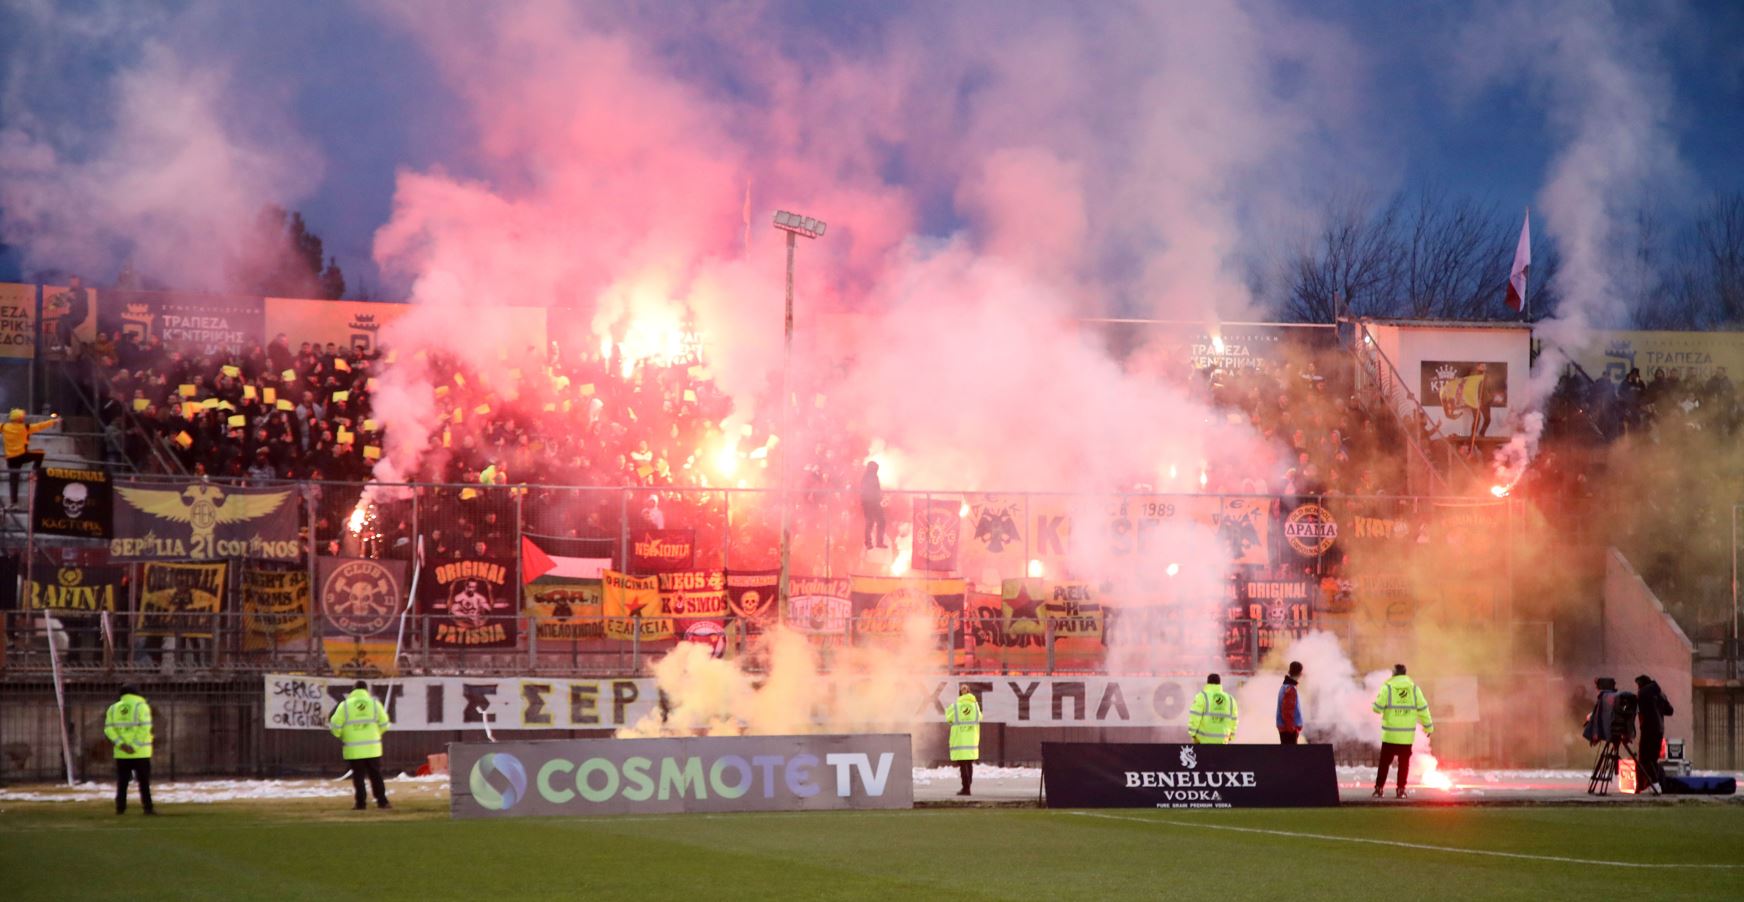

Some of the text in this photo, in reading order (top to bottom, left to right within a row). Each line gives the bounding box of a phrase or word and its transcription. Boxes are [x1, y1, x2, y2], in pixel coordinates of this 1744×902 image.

[161, 314, 229, 329] ΤΡΑΠΕΖΑ
[1646, 351, 1713, 364] ΤΡΑΠΕΖΑ
[46, 467, 106, 482] ORIGINAL
[1142, 503, 1176, 517] 1989
[1286, 523, 1336, 536] ΔΡΑΜΑ
[190, 533, 214, 560] 21
[343, 565, 381, 578] CLUB
[434, 560, 506, 585] ORIGINAL
[606, 576, 656, 590] ORIGINAL
[658, 572, 705, 590] NEOS
[22, 580, 115, 612] RAFINA
[1247, 582, 1308, 599] ORIGINAL
[435, 623, 507, 644] PATISSIA
[273, 680, 324, 699] SERRES
[283, 700, 322, 716] CLUB
[826, 752, 895, 798] TV
[1124, 771, 1257, 788] BENELUXE
[1163, 790, 1222, 801] VODKA
